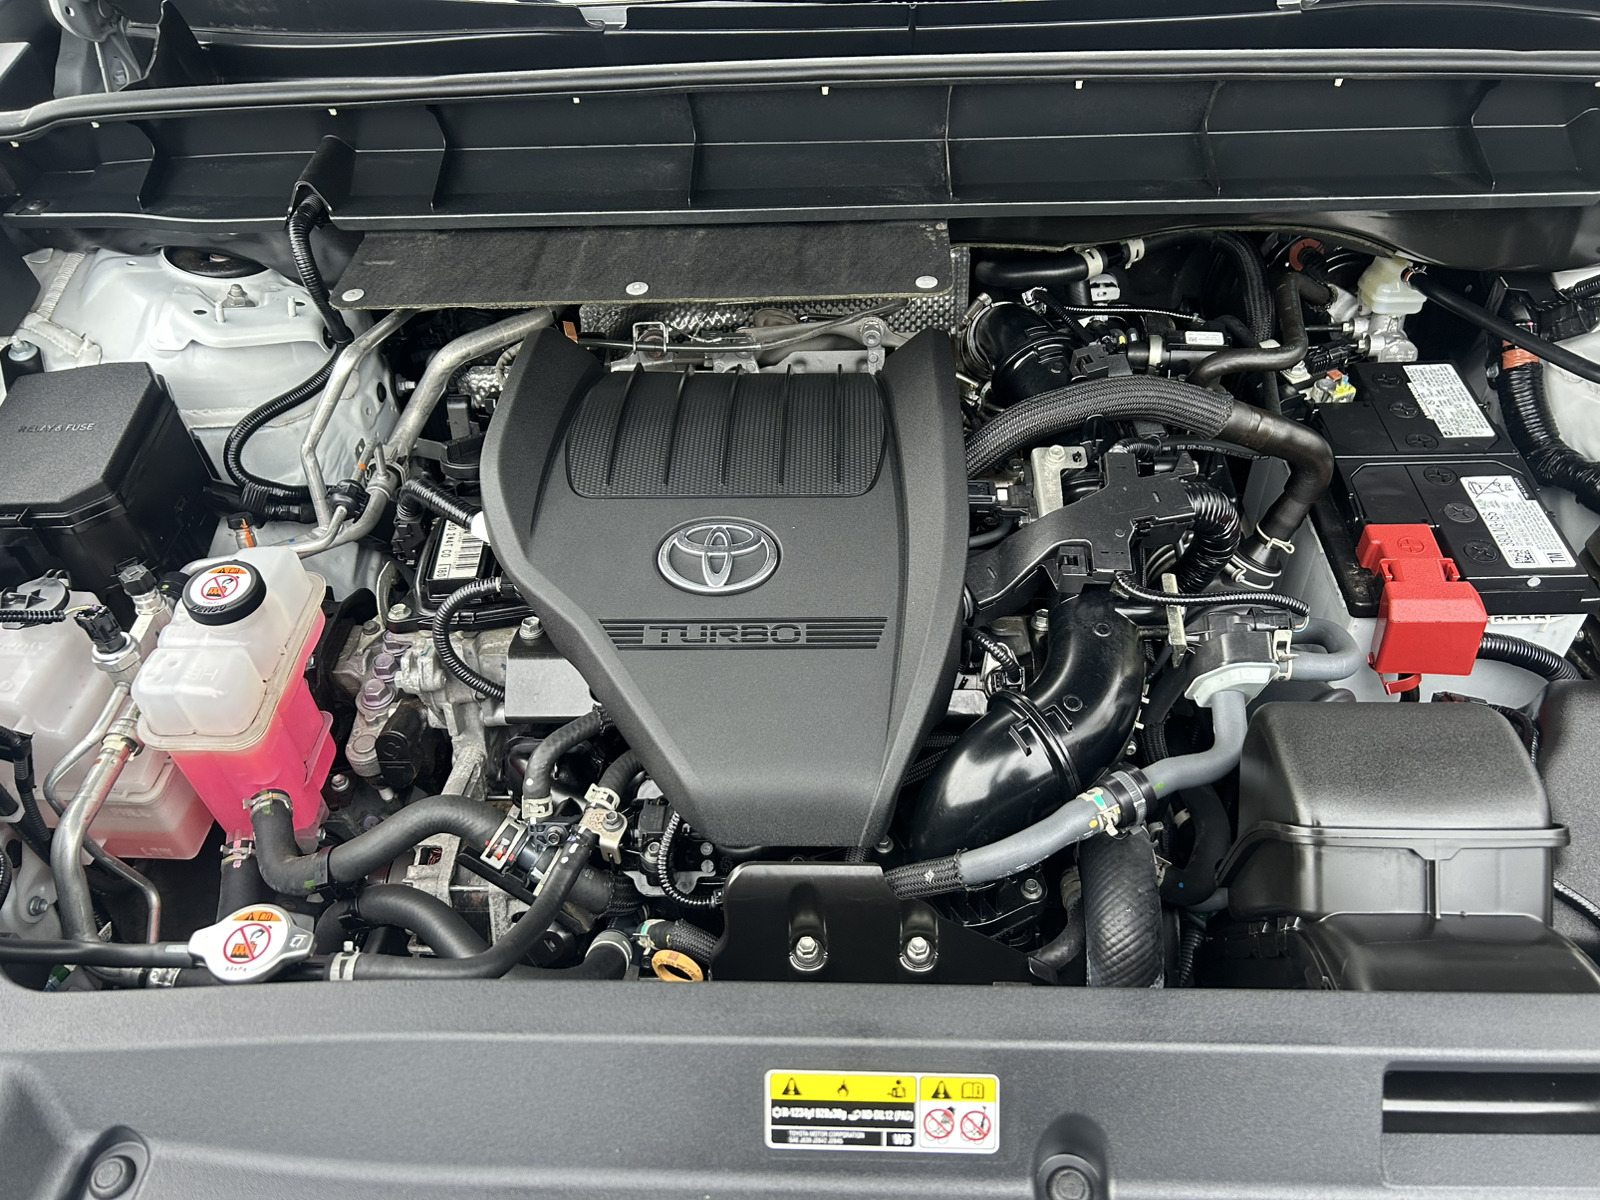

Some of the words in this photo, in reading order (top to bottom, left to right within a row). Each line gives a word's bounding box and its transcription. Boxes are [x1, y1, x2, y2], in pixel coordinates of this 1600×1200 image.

[18, 423, 54, 433] RELAY
[64, 422, 96, 432] FUSE
[190, 603, 227, 613] DENSO
[648, 623, 802, 644] TURBO
[892, 1133, 912, 1146] WS
